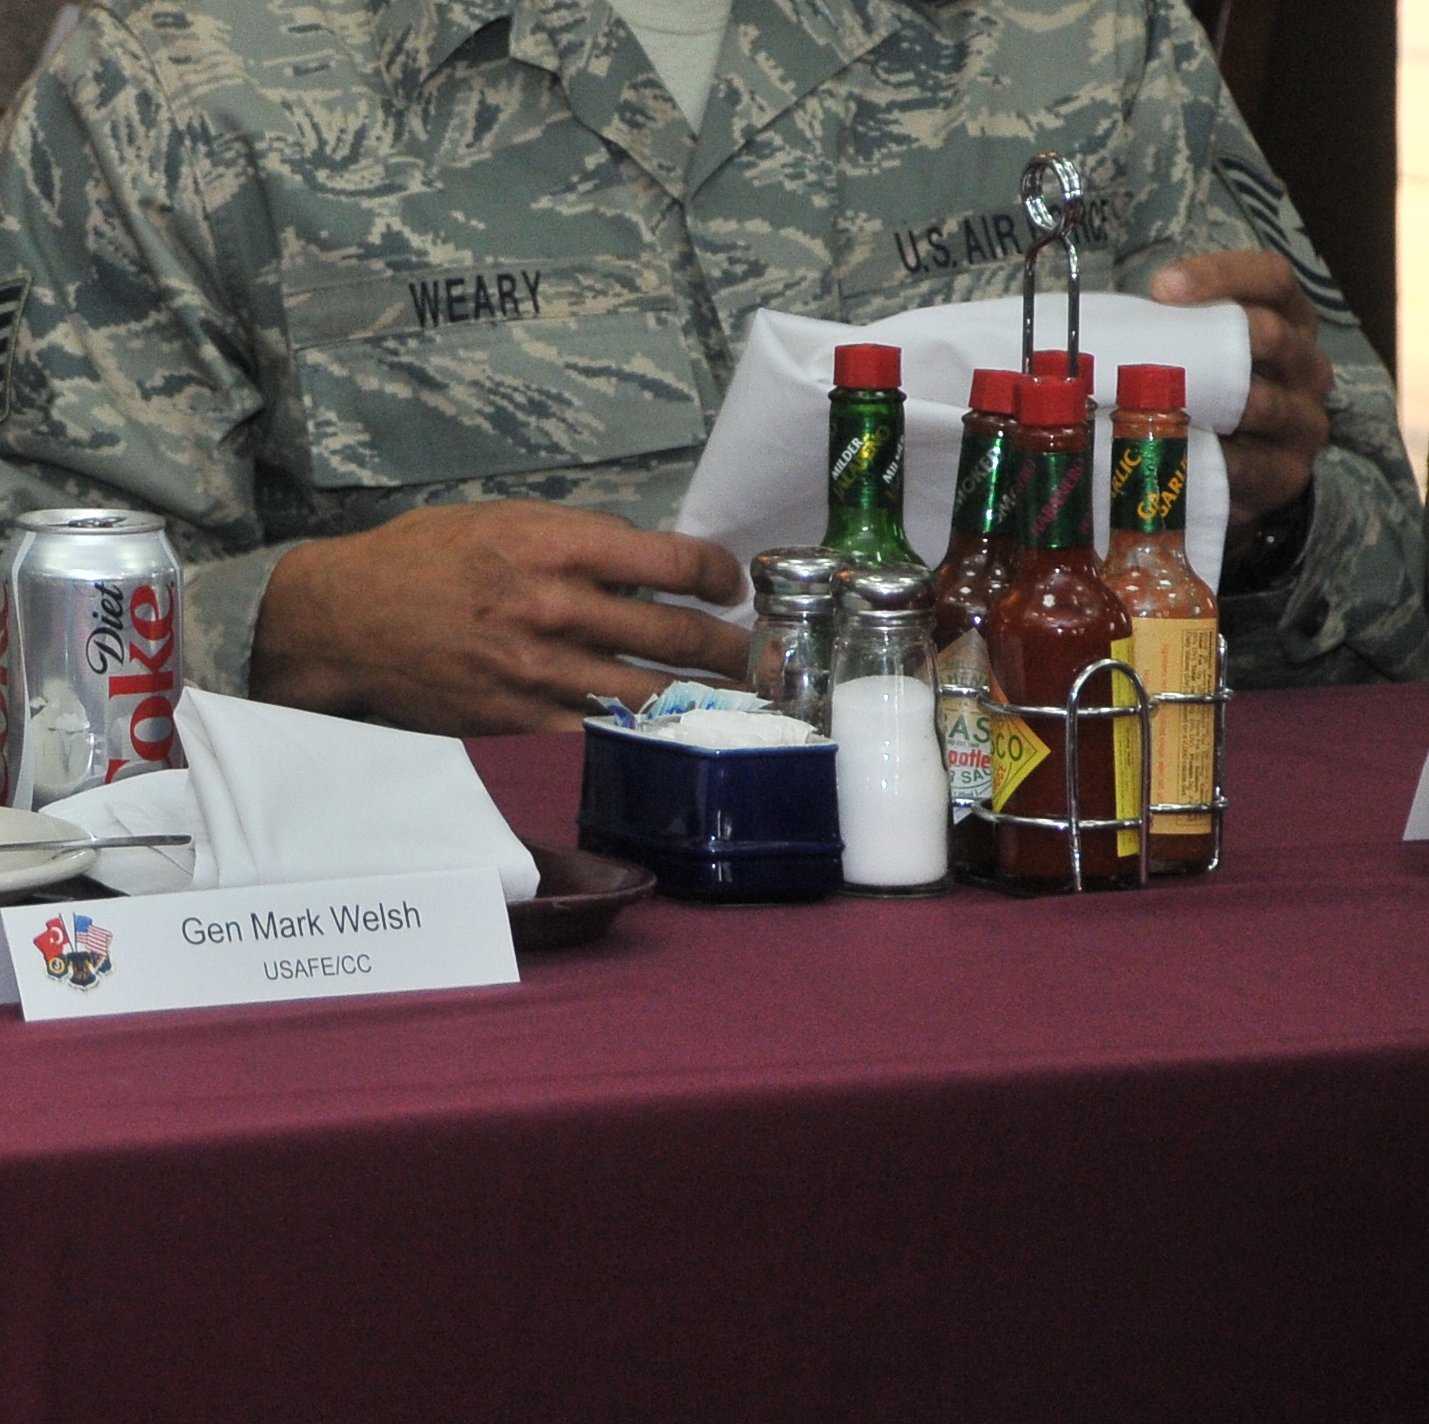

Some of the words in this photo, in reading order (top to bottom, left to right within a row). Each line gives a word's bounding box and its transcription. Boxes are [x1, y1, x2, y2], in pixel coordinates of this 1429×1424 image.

[894, 226, 957, 275] U.S.
[964, 213, 1024, 265] AIR
[408, 271, 541, 328] WEARY
[831, 437, 863, 480] MILDER
[85, 581, 125, 675] Diet
[181, 917, 242, 946] Gen
[251, 909, 325, 942] Mark
[332, 901, 421, 934] Welsh
[263, 953, 372, 982] USAFE/CC
